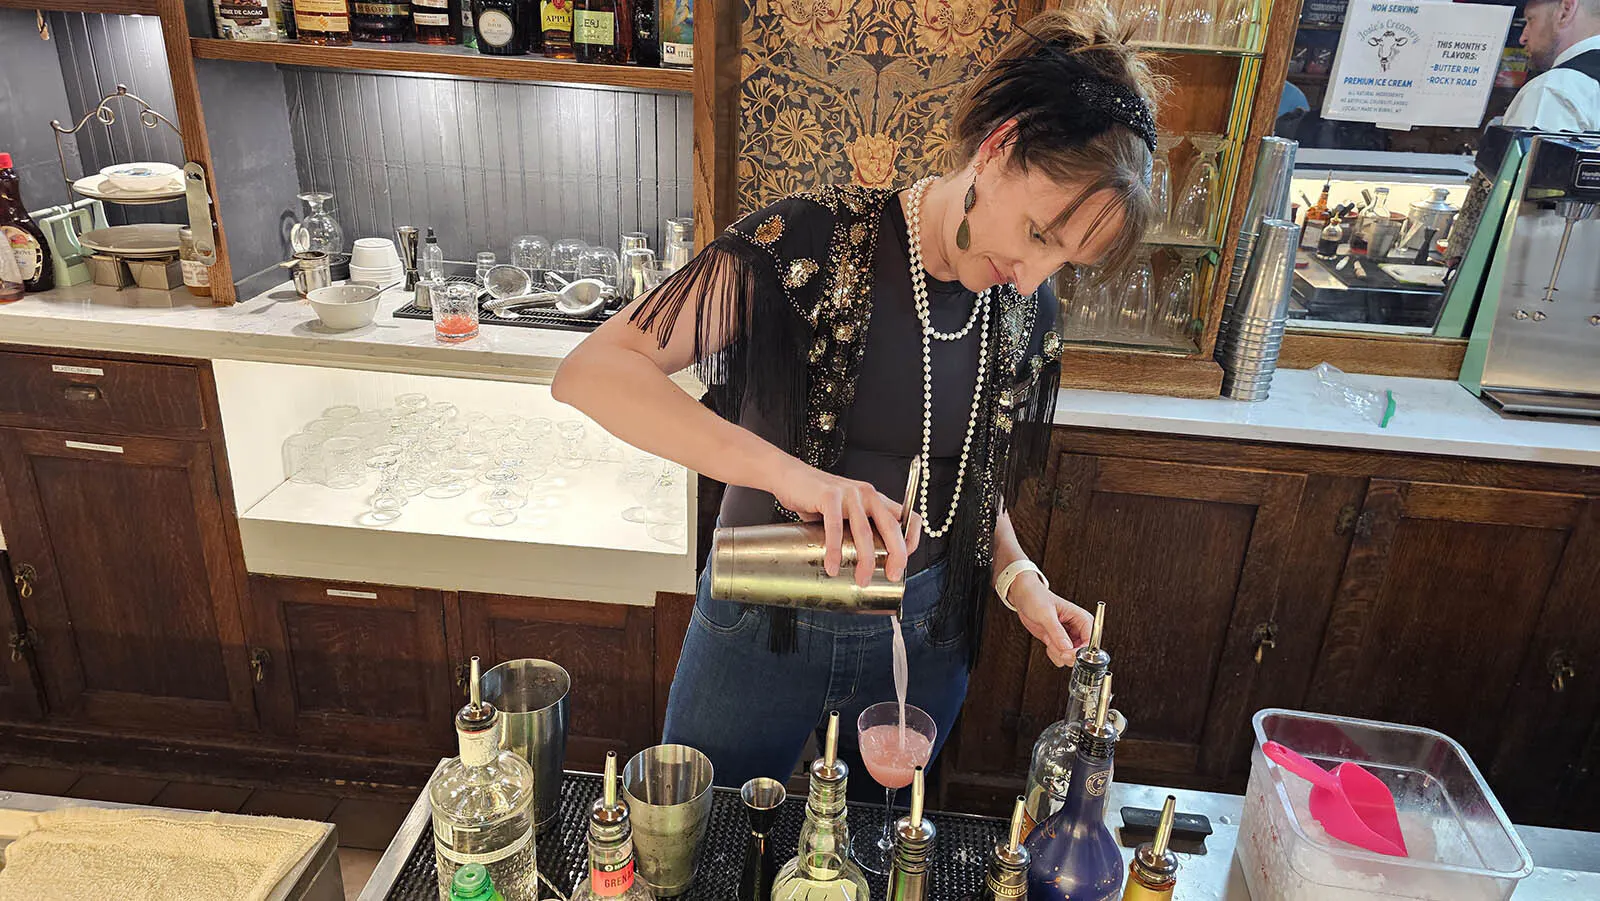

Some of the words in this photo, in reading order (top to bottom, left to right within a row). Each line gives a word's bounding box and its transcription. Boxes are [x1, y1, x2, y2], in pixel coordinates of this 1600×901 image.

[1371, 4, 1387, 12] NOW
[1387, 5, 1419, 14] SERVING
[584, 19, 600, 28] E&J
[1437, 41, 1453, 49] THIS
[1454, 42, 1487, 51] MONTH'S
[1442, 51, 1478, 60] FLAVORS:
[1463, 66, 1480, 74] RUM
[1343, 76, 1374, 85] PREMIUM
[1374, 79, 1387, 87] ICE
[1388, 79, 1413, 88] CREAM
[1456, 78, 1478, 87] ROAD
